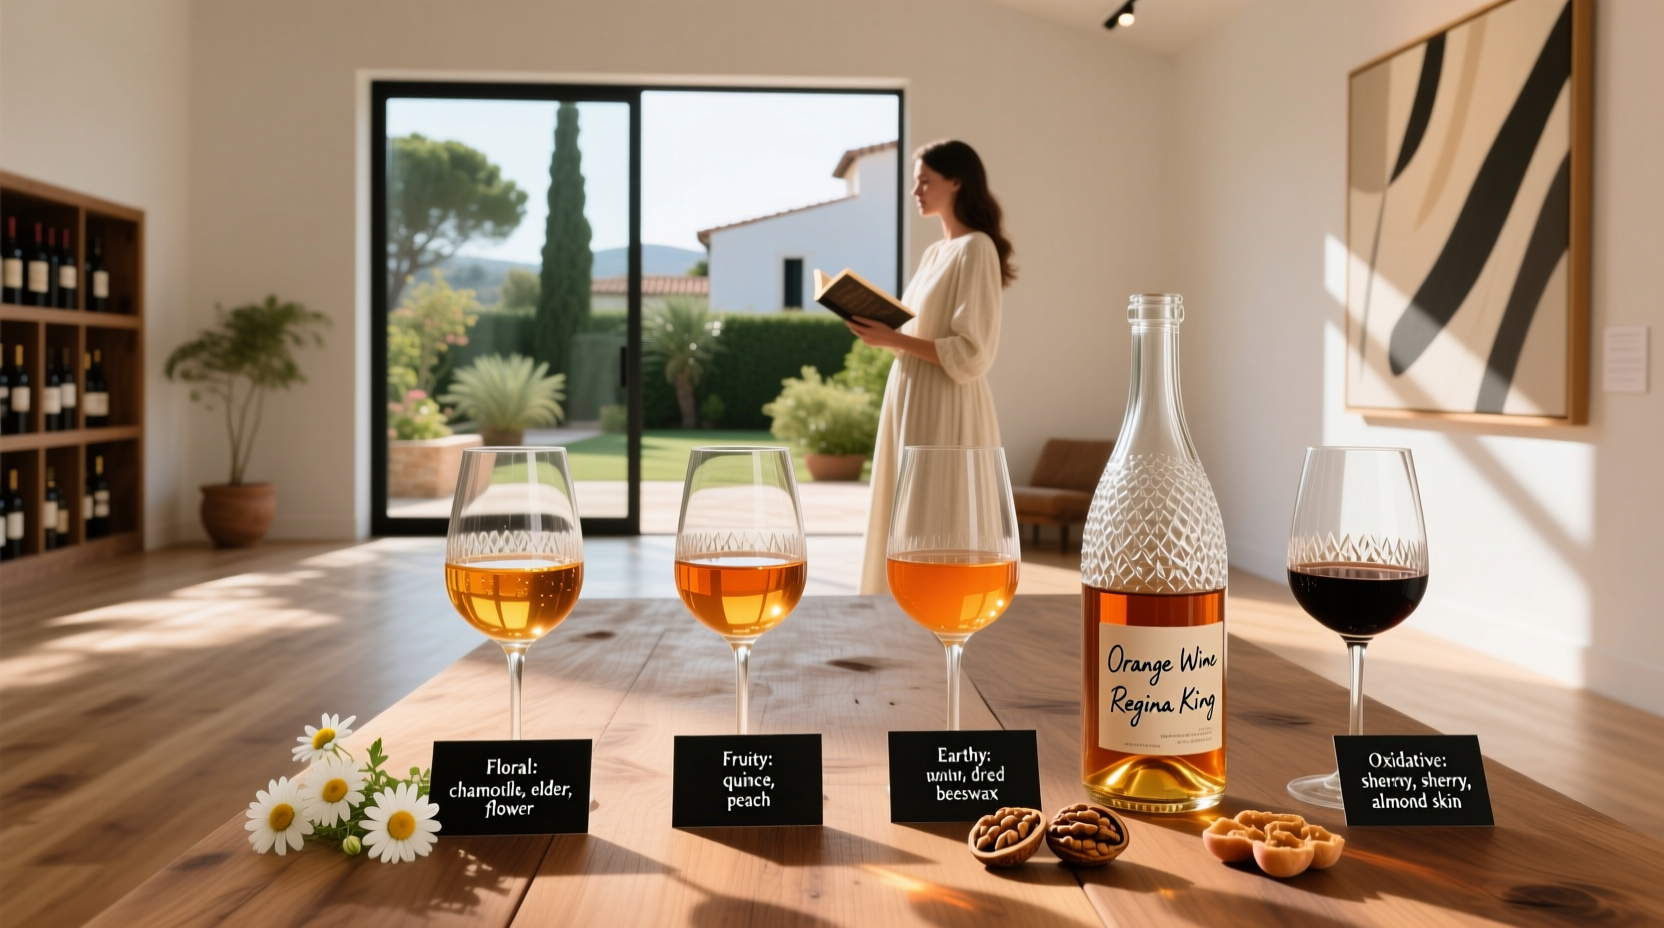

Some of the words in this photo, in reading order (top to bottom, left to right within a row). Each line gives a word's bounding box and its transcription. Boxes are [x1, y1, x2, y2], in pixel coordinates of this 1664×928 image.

[1107, 644, 1174, 686] Orange
[1180, 646, 1218, 673] Wine
[1110, 685, 1174, 727] Regina
[1179, 686, 1216, 721] King
[723, 751, 773, 770] Fruity:
[938, 746, 991, 766] Earthy:
[1368, 751, 1447, 768] Oxidative:
[486, 758, 538, 775] Floral:
[971, 766, 1005, 782] dred
[531, 779, 573, 800] elder,
[723, 772, 775, 792] quince,
[1421, 771, 1472, 792] sherry,
[727, 791, 771, 812] peach
[936, 785, 999, 801] beeswax
[1372, 792, 1428, 809] almond
[1433, 791, 1462, 809] skin
[485, 799, 534, 819] flower
